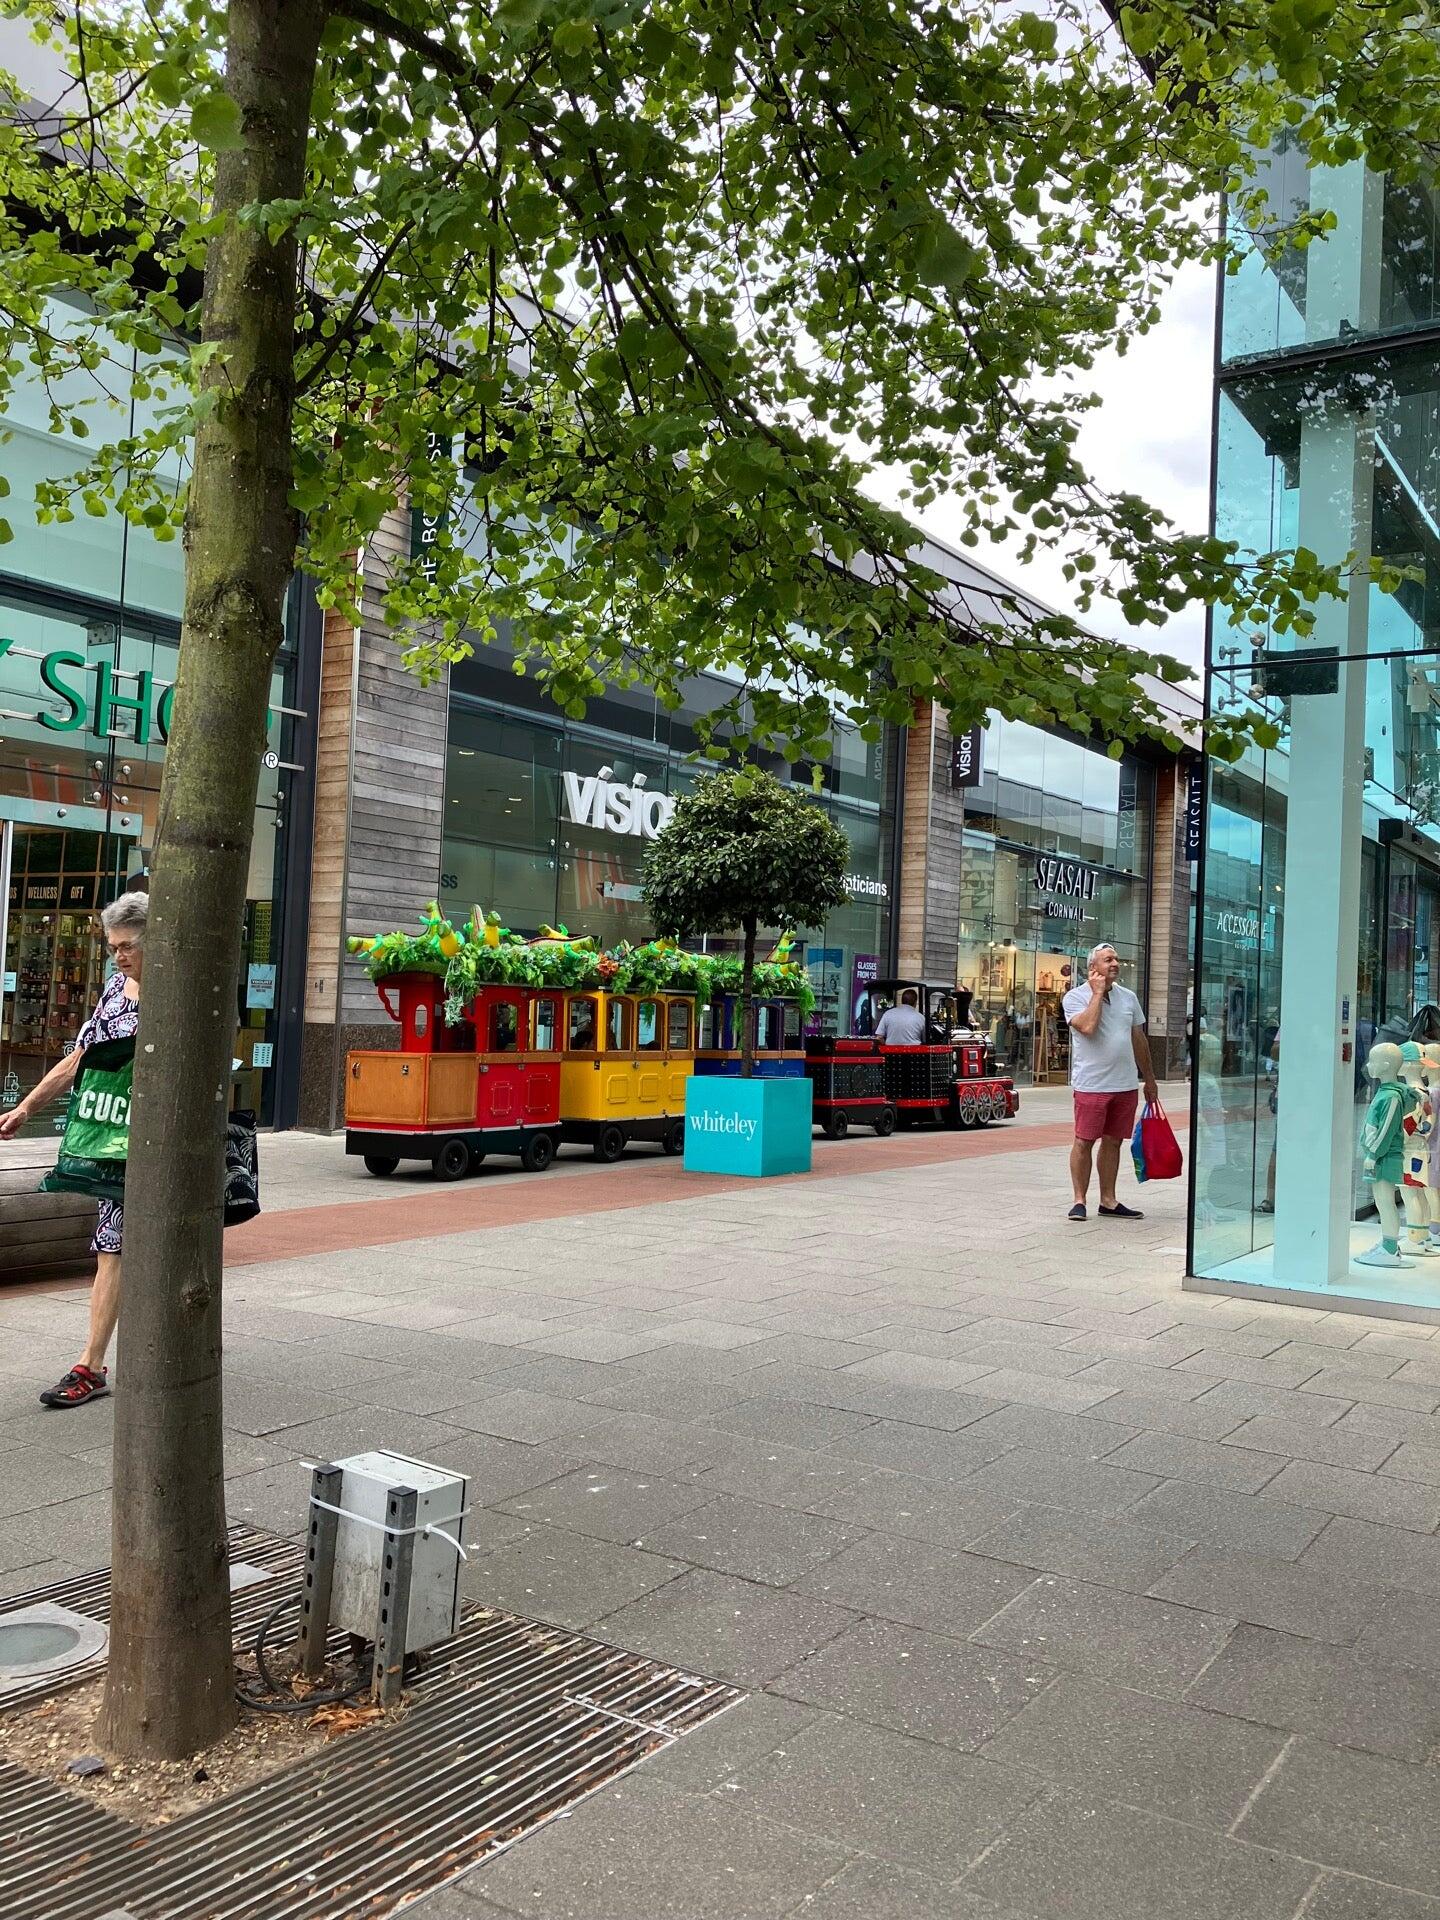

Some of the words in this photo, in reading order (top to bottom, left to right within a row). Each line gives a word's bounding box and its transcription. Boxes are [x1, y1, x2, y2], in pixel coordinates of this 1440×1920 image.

[563, 766, 675, 840] visio
[1037, 858, 1099, 900] SEASALT
[28, 886, 58, 899] WELLNESS
[70, 886, 84, 899] GIFT
[1048, 901, 1086, 922] CORNWALL
[1217, 912, 1267, 940] ACCESSORE
[856, 970, 869, 979] FROM
[857, 961, 877, 970] GLASSES
[690, 1110, 758, 1141] whiteley
